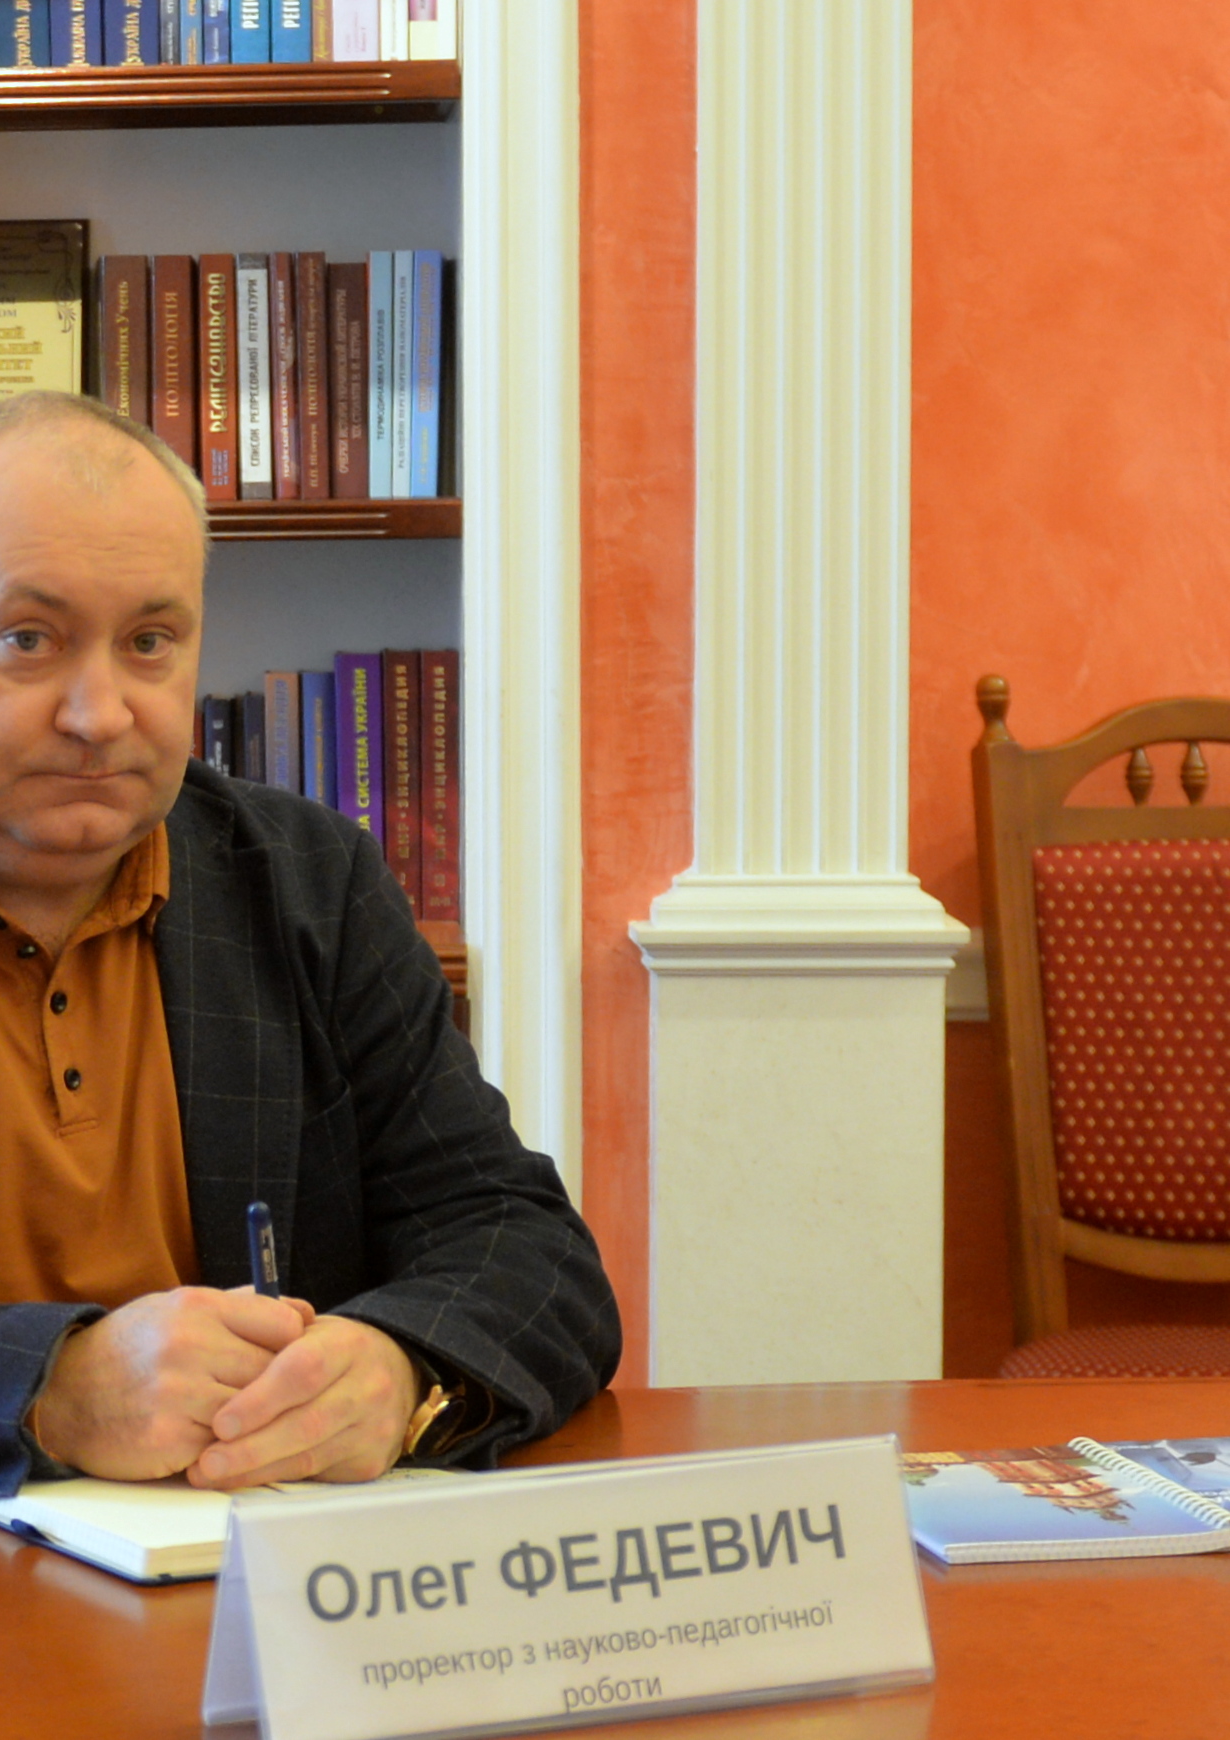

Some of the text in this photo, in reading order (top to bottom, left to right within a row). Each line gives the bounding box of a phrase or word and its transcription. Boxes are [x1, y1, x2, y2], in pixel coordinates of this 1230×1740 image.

[14, 15, 32, 65] УКРАЇНА
[123, 12, 141, 62] УКРАЇНА
[115, 281, 130, 417] Економічних Учень
[165, 291, 180, 417] ПОЛІТОЛОГІЯ
[208, 272, 227, 433] РЕЛІГІЄЗНАВСТВО
[248, 279, 261, 467] СПИСОК РЕПРЕСОВАНОЇ ЛІТЕРАТУРИ
[307, 331, 318, 416] ПОЛІТОЛОГІЯ
[377, 308, 386, 440] ТЕРМОДИНАМІКА РОЗПЛАВІВ
[339, 440, 350, 474] ОЧЕРКИ
[352, 667, 367, 733] УКРАЇНИ
[355, 737, 369, 808] СИСТЕМА
[306, 1504, 846, 1623] Олег ФЕДЕВИЧ
[362, 1600, 835, 1689] проректор з науково-педагогічної
[562, 1675, 663, 1710] роботи
